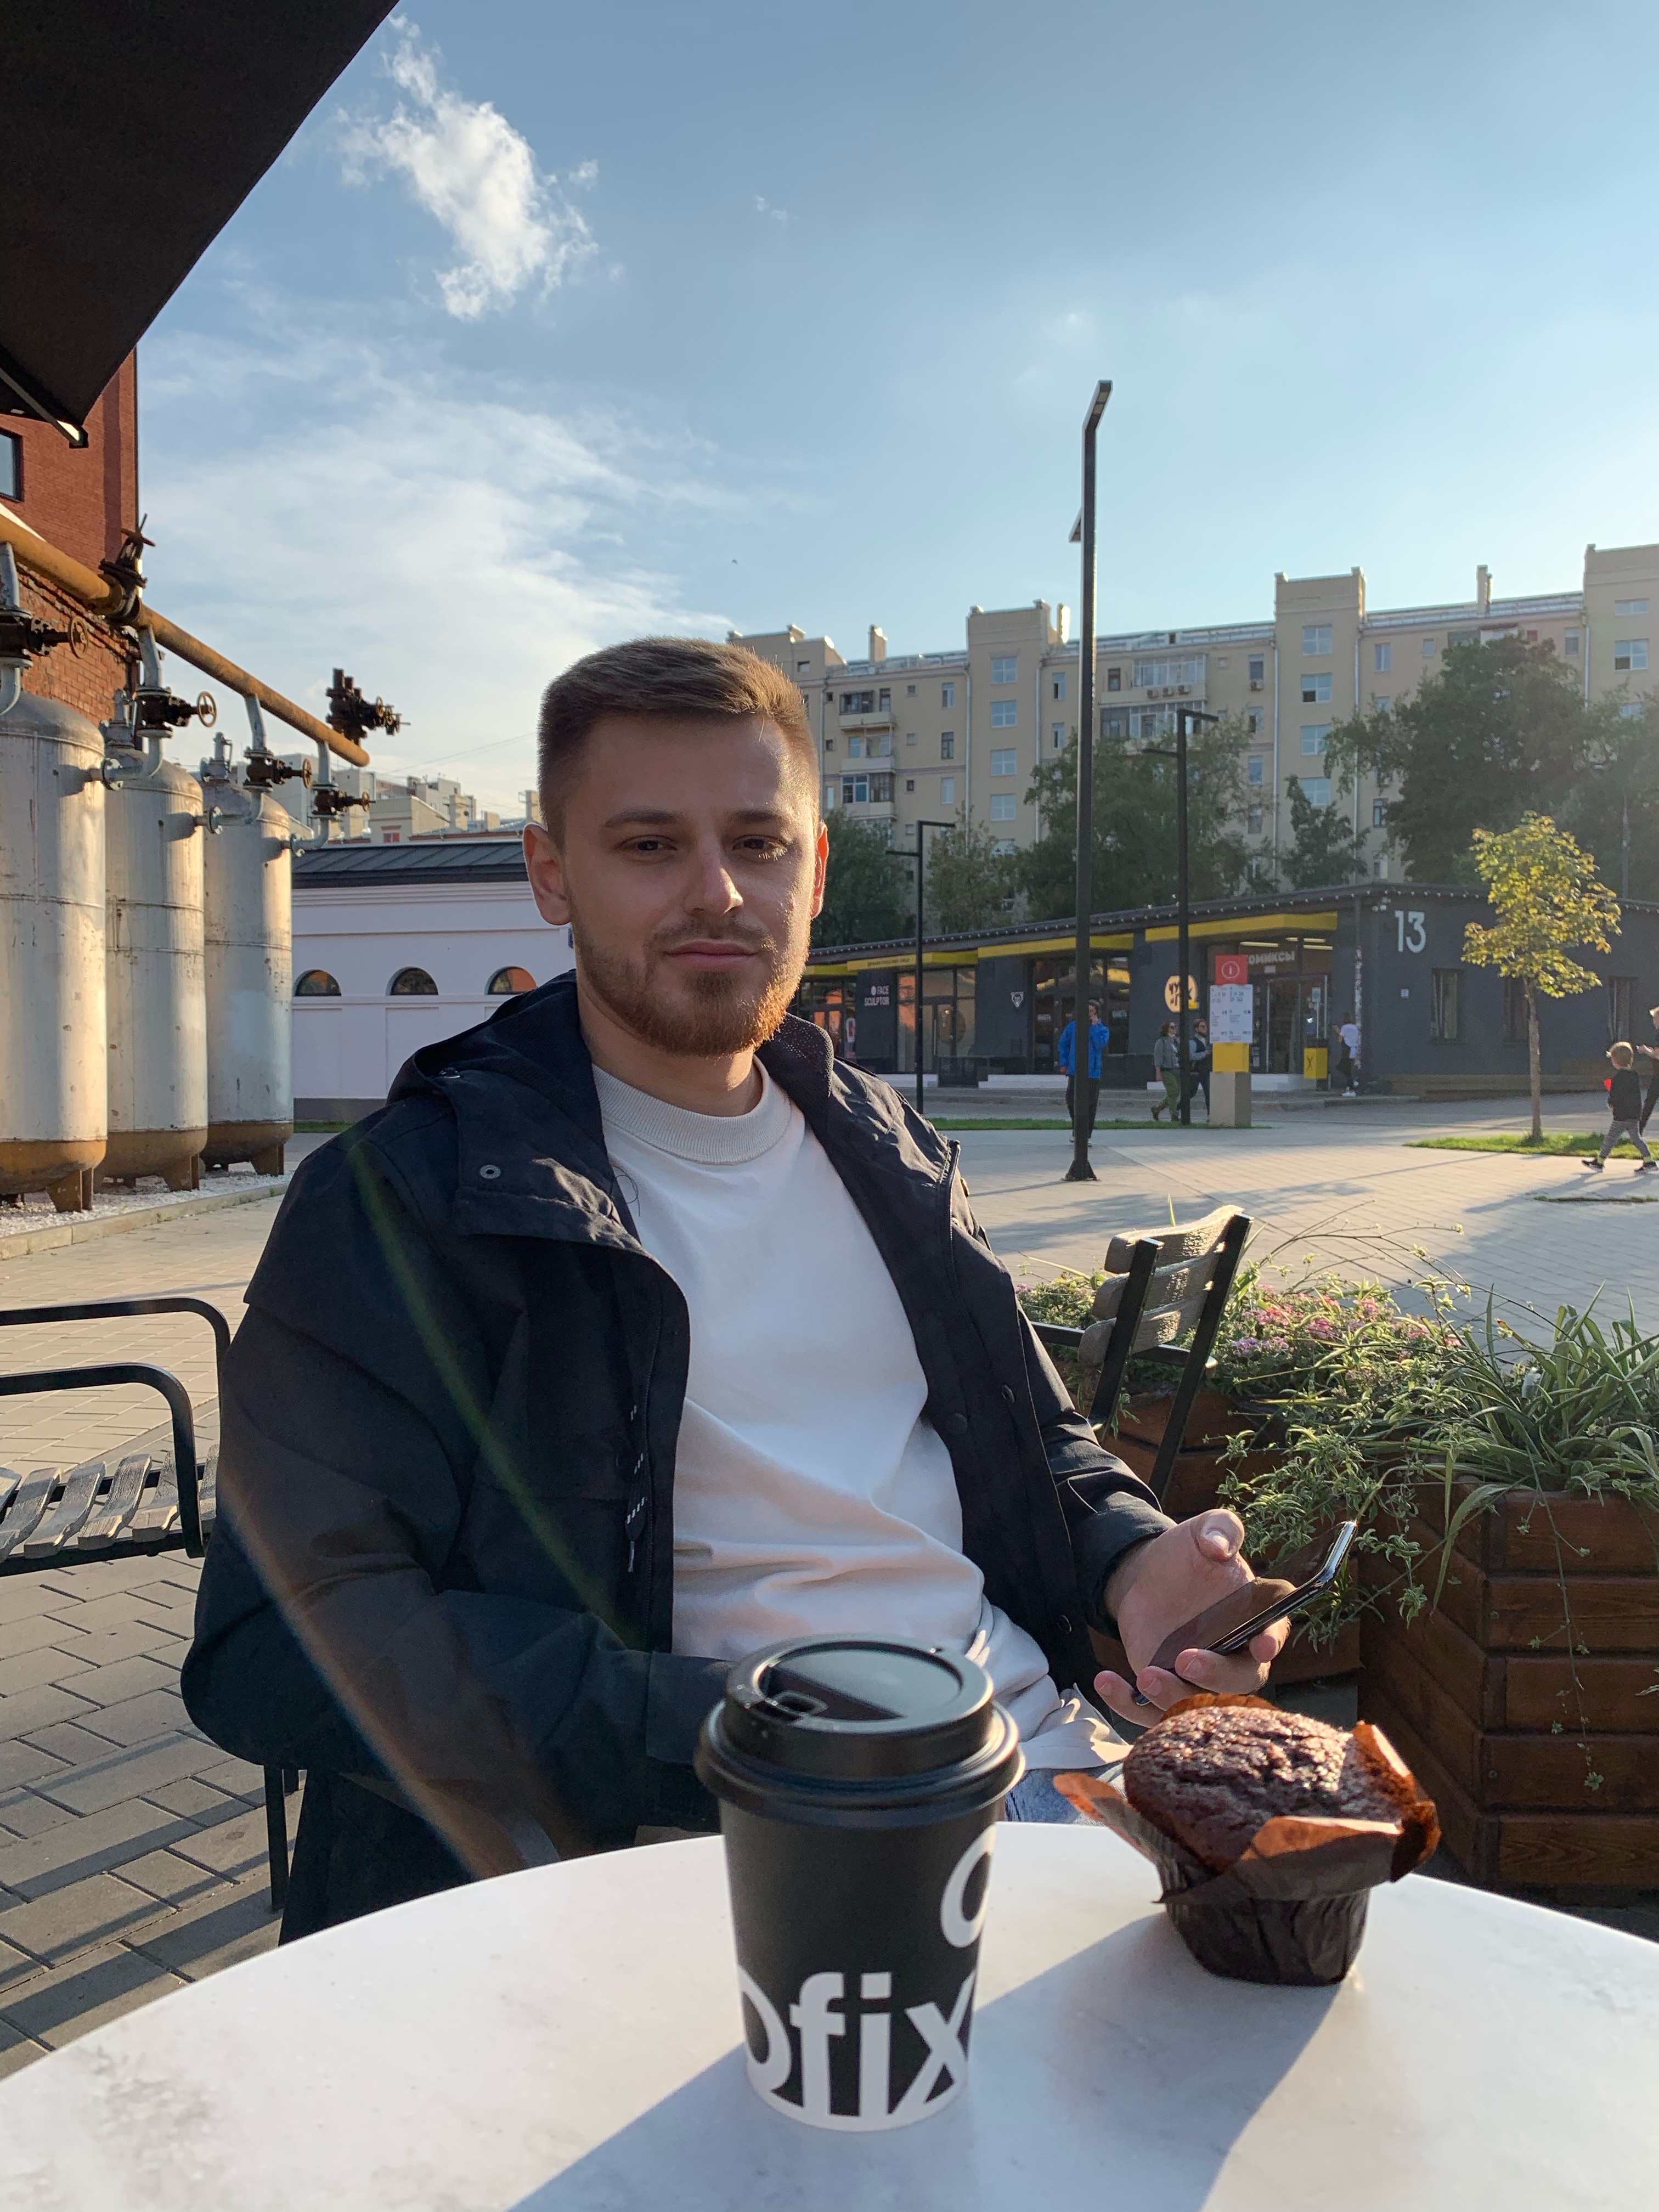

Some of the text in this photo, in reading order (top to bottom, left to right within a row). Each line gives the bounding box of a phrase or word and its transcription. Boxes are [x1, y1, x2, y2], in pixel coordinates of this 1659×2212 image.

[1395, 910, 1426, 953] 13
[1249, 951, 1295, 965] ОМИКСЫ
[877, 985, 889, 995] FACE
[864, 996, 890, 1006] SCULPTOR
